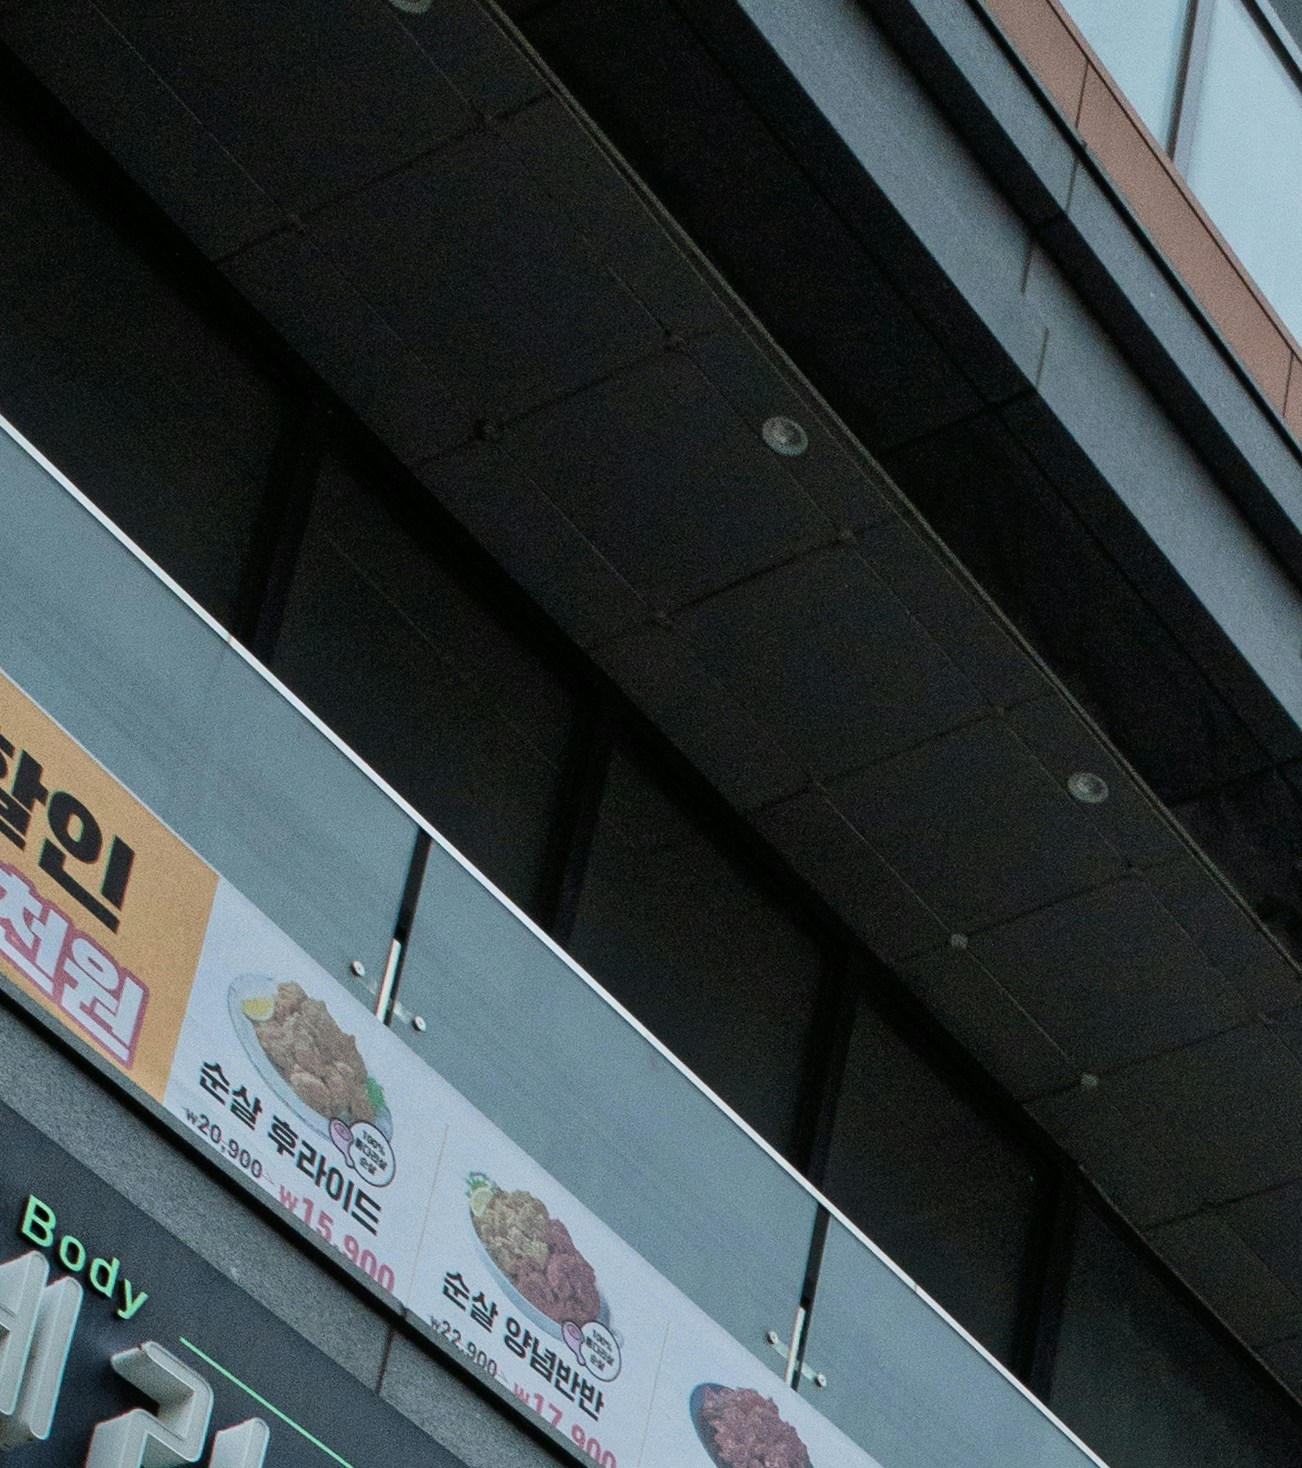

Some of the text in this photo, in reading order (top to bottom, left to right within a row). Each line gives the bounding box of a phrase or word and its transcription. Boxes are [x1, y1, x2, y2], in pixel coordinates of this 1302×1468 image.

[199, 1061, 382, 1237] 순살 후라이드
[20, 1194, 149, 1320] Body
[442, 1271, 605, 1422] 순살 양념반반
